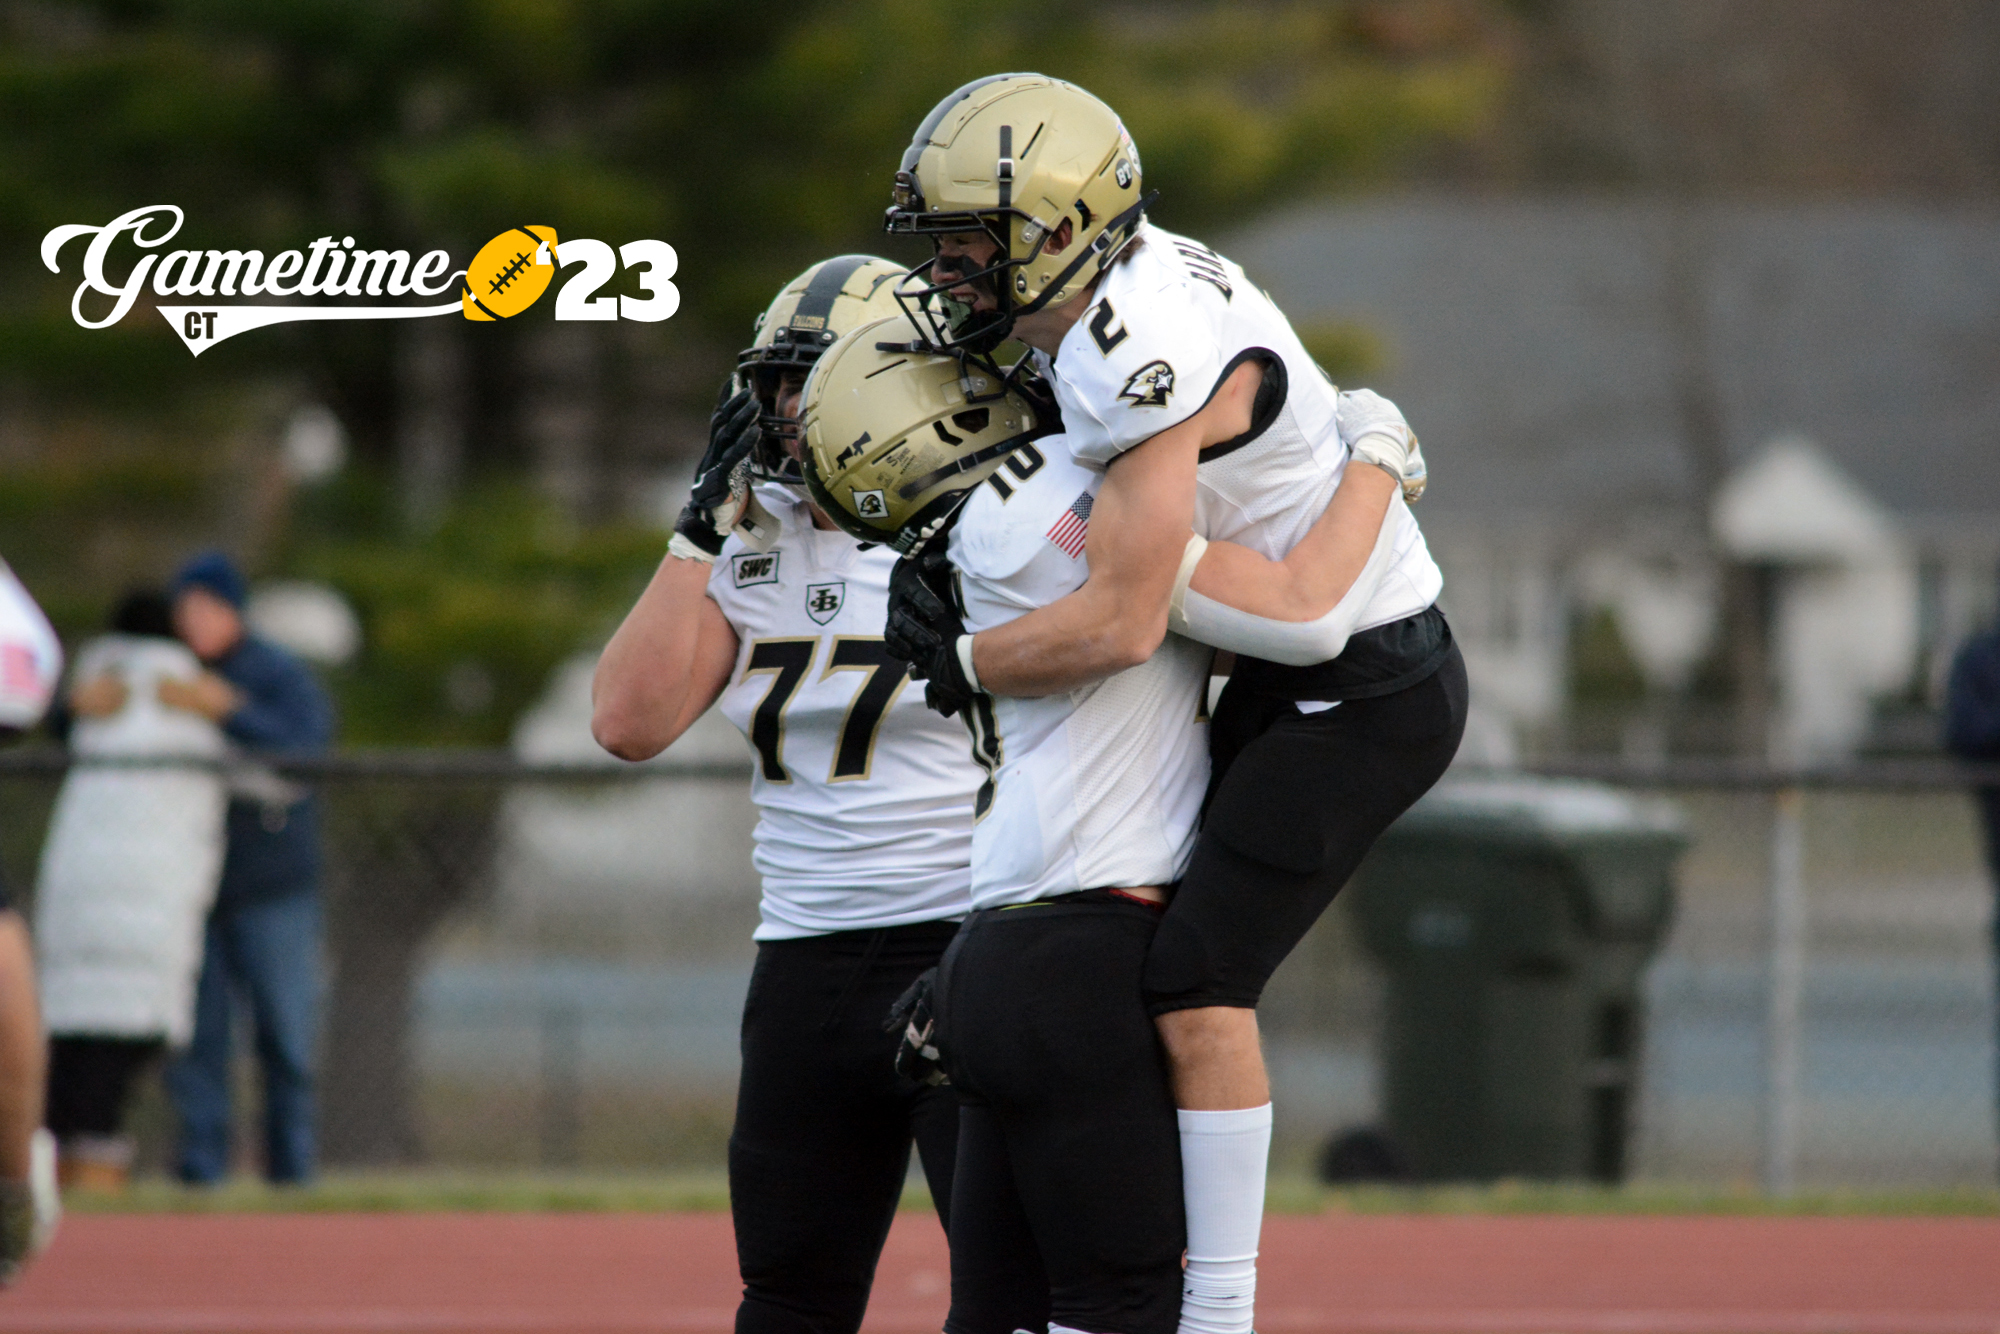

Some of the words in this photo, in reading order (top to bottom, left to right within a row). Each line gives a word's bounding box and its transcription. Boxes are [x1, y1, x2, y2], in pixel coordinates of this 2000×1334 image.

[1081, 296, 1131, 360] 2
[738, 557, 774, 580] SWC
[741, 634, 910, 785] 77
